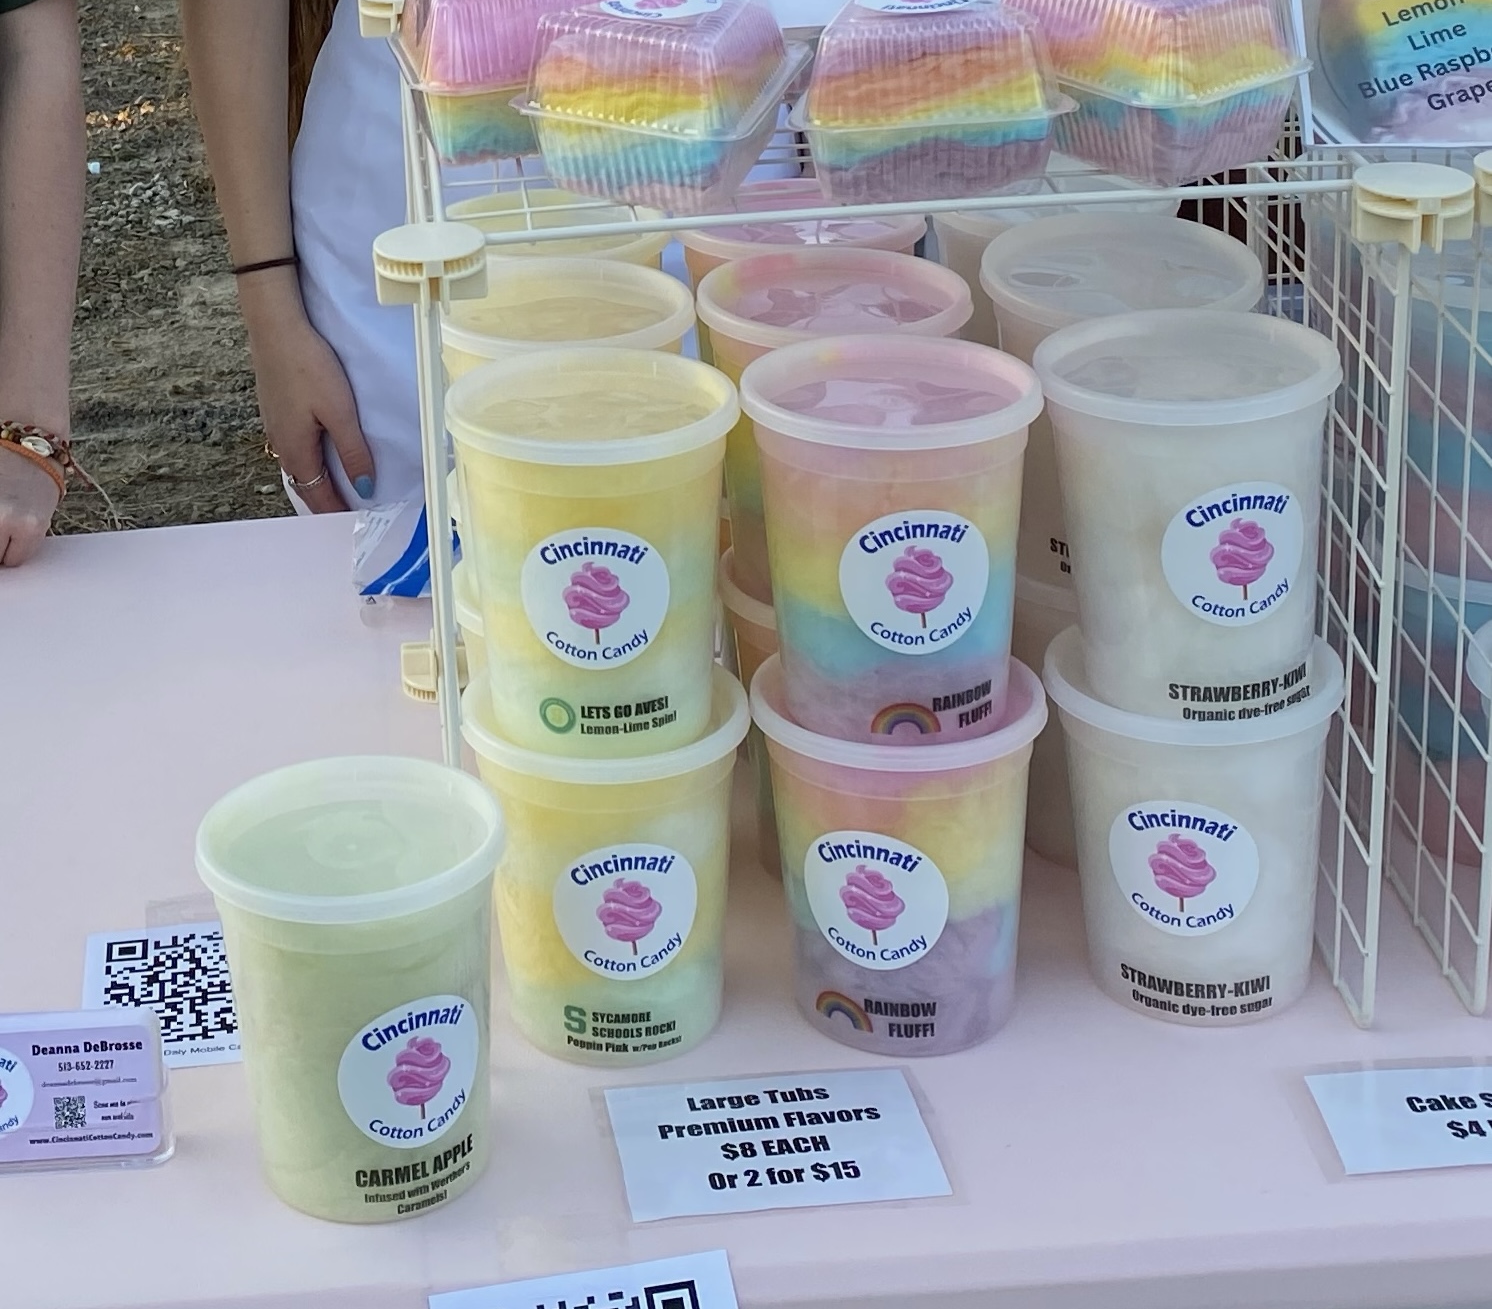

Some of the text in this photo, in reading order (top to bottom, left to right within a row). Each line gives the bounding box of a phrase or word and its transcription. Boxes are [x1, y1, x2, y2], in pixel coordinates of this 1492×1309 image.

[1407, 23, 1467, 51] Lime
[1357, 46, 1492, 99] Blue Raspb
[1185, 493, 1290, 528] Cincinnati
[540, 536, 648, 565] Cincinnati
[859, 520, 970, 554] Cincinnati
[1191, 578, 1290, 618] Cotton Candy
[870, 607, 972, 646] Cotton Candy
[546, 629, 649, 660] Cotton Candy
[933, 679, 992, 713] RAINBOW
[1168, 661, 1306, 703] STRAWBERRY-KIWI
[580, 696, 668, 720] LETS GO AVES!
[580, 710, 677, 735] Lemon-Lime Spin!
[958, 700, 992, 729] FLUFF!
[1183, 707, 1235, 722] Organic
[1128, 809, 1238, 842] Cincinnati
[570, 854, 676, 886] Cincinnati
[818, 840, 922, 873] Cincinnati
[1131, 892, 1235, 928] Cotton Candy
[584, 932, 682, 972] Cotton Candy
[828, 927, 928, 961] Cotton Candy
[1120, 962, 1270, 999] STRAWBERRY-KIWI
[592, 1011, 651, 1024] SYCAMORE
[864, 998, 937, 1018] RAINBOW
[1132, 988, 1273, 1017] Organic dye-free sugar
[361, 1003, 465, 1052] Cincinnati
[563, 1005, 587, 1034] S
[592, 1020, 676, 1038] SCHOOLS ROCK!
[888, 1023, 935, 1039] FLUFF!
[32, 1040, 143, 1056] Deanna DeBrosse
[567, 1035, 603, 1052] Poppin
[605, 1042, 629, 1053] Pink
[369, 1088, 466, 1140] Cotton Candy
[687, 1087, 830, 1112] Large Tubs
[1406, 1094, 1478, 1113] Cake
[657, 1107, 881, 1139] Premium Flavors
[1446, 1120, 1487, 1139] $4
[355, 1133, 473, 1188] CARMEL APPLE
[720, 1135, 831, 1161] $8 EACH
[364, 1161, 470, 1204] Infused with Werther's
[708, 1160, 861, 1190] Or 2 for $15
[397, 1189, 447, 1215] Caramels!
